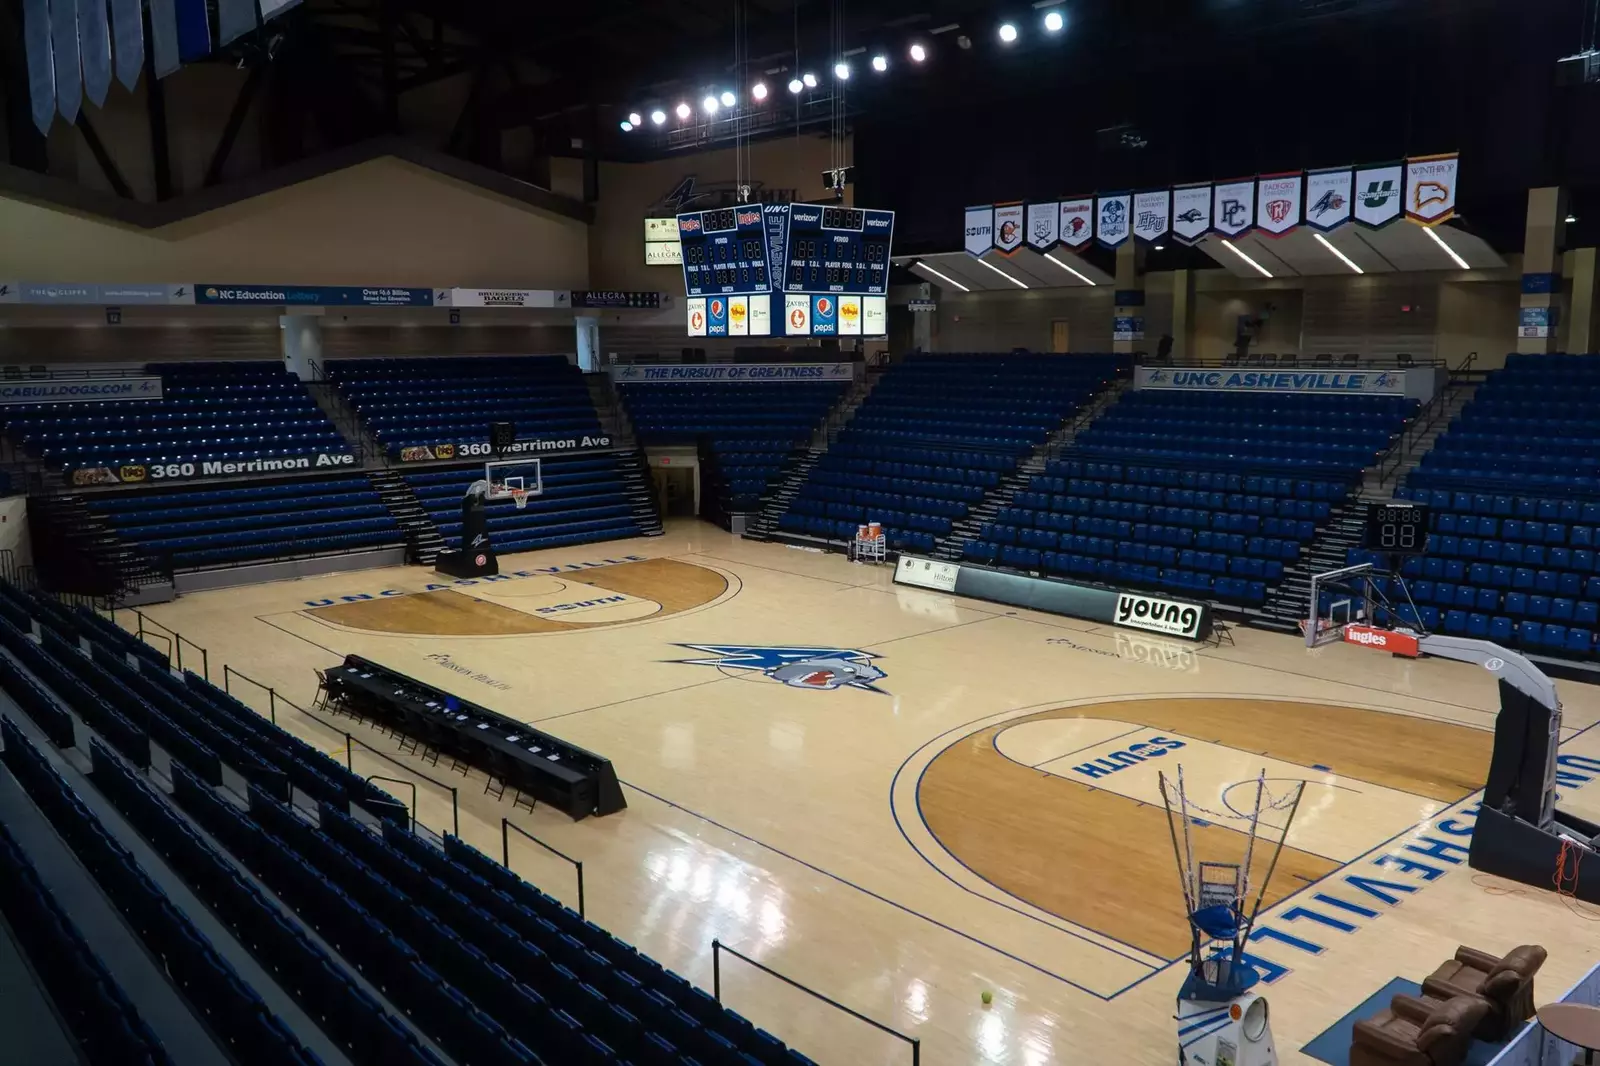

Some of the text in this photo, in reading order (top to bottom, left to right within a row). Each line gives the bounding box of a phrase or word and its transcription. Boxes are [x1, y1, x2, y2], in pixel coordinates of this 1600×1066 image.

[1410, 164, 1454, 176] WINTHROP
[764, 205, 789, 213] UNC
[794, 213, 819, 222] verizon
[966, 226, 991, 236] SOUTH
[769, 215, 785, 289] ASHEVILLE
[219, 290, 235, 299] NC
[236, 290, 285, 300] Education
[586, 292, 626, 300] ALLEGRA
[814, 323, 834, 332] pepsi
[644, 366, 824, 378] THE PURSUIT OF GREATNESS
[1173, 372, 1367, 389] UNC ASHEVILLE
[458, 443, 491, 457] 360
[581, 436, 609, 447] Ave
[151, 463, 195, 479] 360
[203, 457, 309, 476] Merrimon
[316, 453, 354, 467] Ave
[305, 555, 647, 606] UNC ASHEVILLE
[536, 595, 626, 614] SOUTH
[1119, 597, 1197, 634] young
[1349, 629, 1387, 645] ingles
[1072, 737, 1187, 779] SOUTH
[1556, 754, 1600, 802] UN
